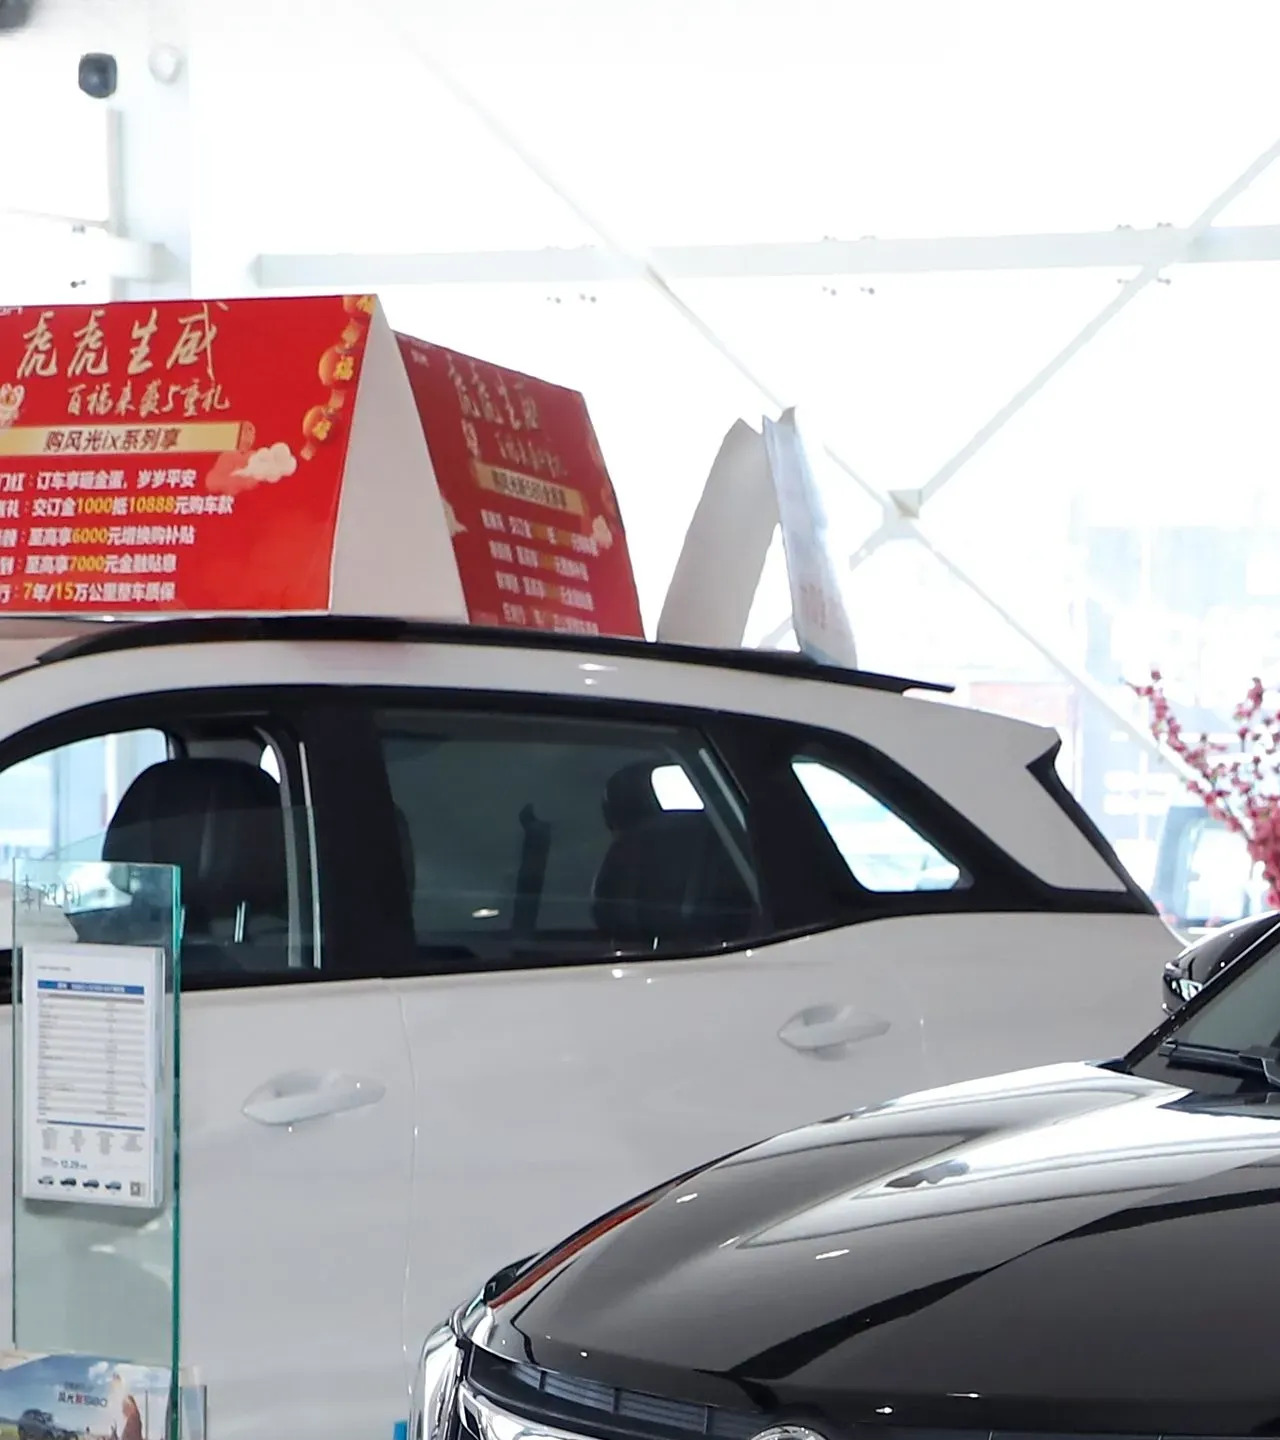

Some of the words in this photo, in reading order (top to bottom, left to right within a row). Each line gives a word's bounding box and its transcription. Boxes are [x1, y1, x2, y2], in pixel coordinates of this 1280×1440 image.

[16, 302, 229, 382] 虎虎生威
[43, 427, 182, 454] 购风光ix系列享
